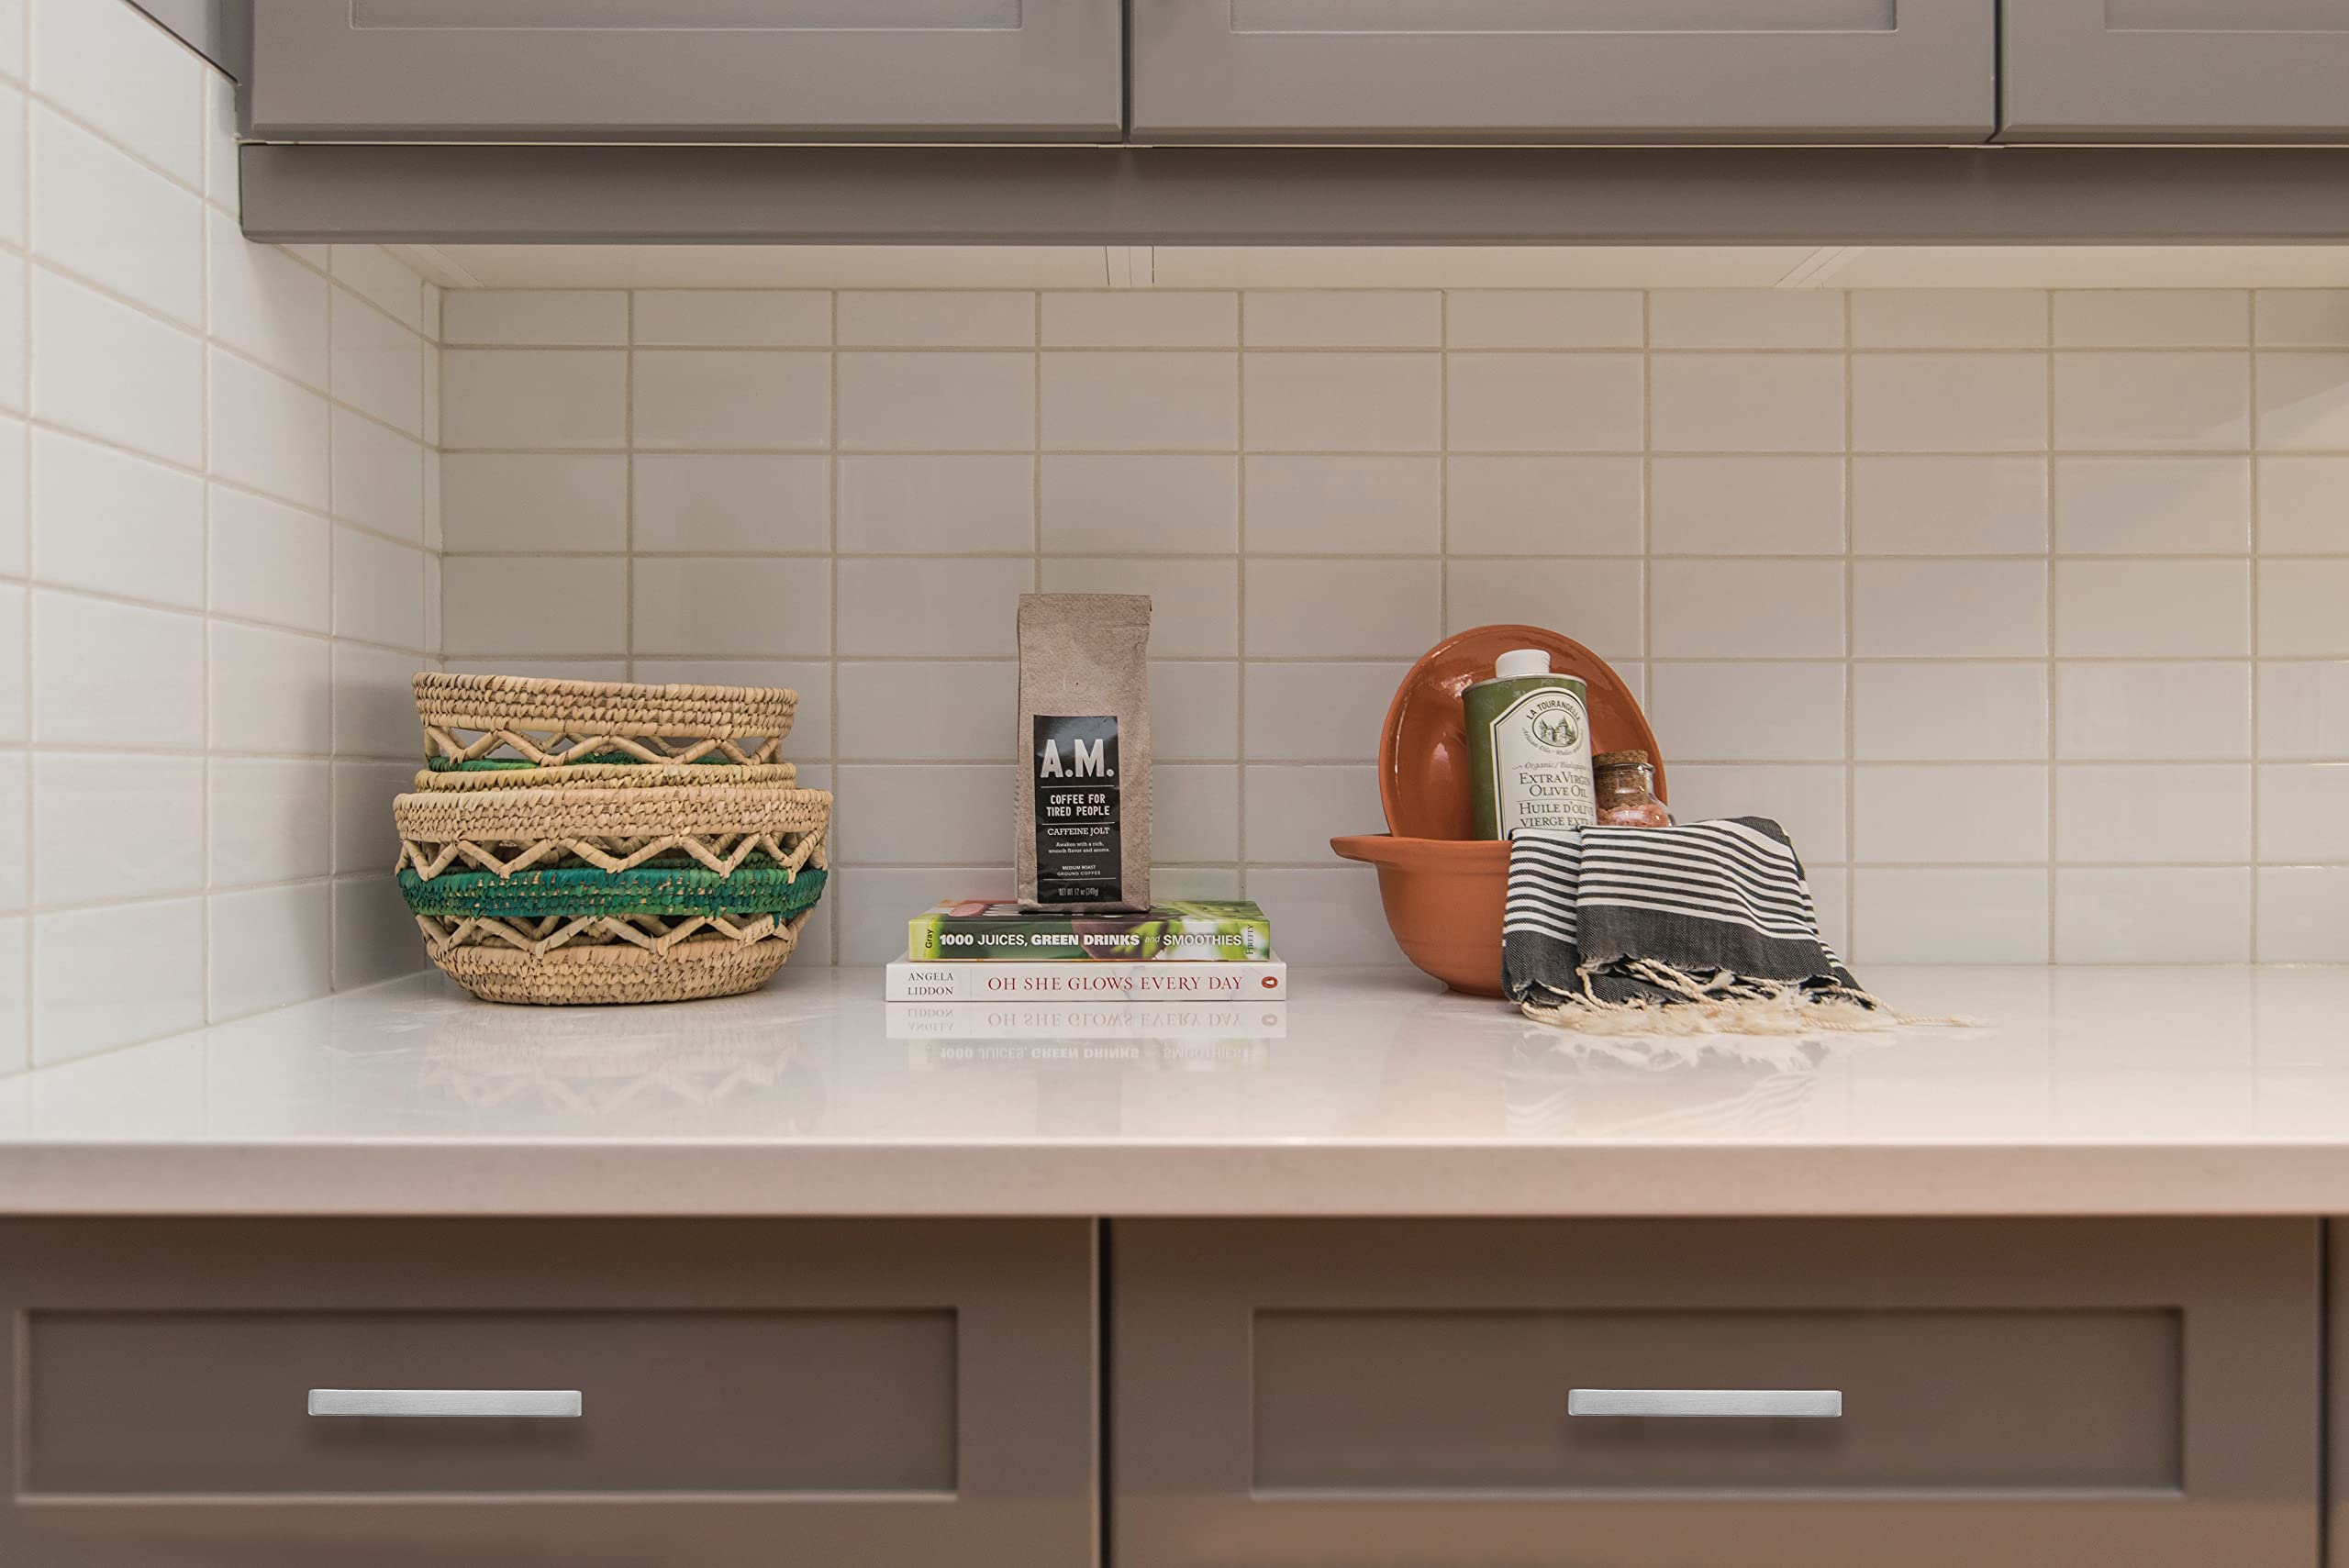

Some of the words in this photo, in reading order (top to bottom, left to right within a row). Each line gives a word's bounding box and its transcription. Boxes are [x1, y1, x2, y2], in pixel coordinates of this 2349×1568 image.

[1526, 709, 1538, 720] LA
[1041, 739, 1115, 778] A.M.
[1519, 772, 1562, 785] EXTRA
[1530, 784, 1570, 796] OLIVE
[1571, 784, 1587, 797] OIL
[1050, 794, 1085, 805] COFFEE
[1088, 794, 1106, 804] FOR
[1046, 806, 1072, 817] TIRED
[1076, 806, 1110, 817] PEOPLE
[1519, 802, 1561, 815] HUILE
[1520, 817, 1565, 827] VIERGE
[1047, 828, 1089, 836] CAFFEINE
[1090, 827, 1110, 837] JOLT
[1074, 887, 1080, 896] 12
[925, 929, 933, 949] Gray
[940, 934, 974, 946] 1000
[977, 934, 1028, 947] JUICES,
[1030, 934, 1079, 946] GREEN
[1084, 934, 1140, 946] DRINKS
[1144, 934, 1161, 944] and
[1163, 934, 1242, 946] SMOOTHIES
[1245, 924, 1253, 955] FIREFLY
[908, 972, 953, 982] ANGELA
[987, 977, 1016, 990] OH
[1024, 977, 1062, 990] SHE
[1067, 976, 1133, 991] GLOWS
[1141, 976, 1201, 991] EVERY
[1208, 976, 1242, 990] DAY
[907, 986, 953, 995] LIDDON
